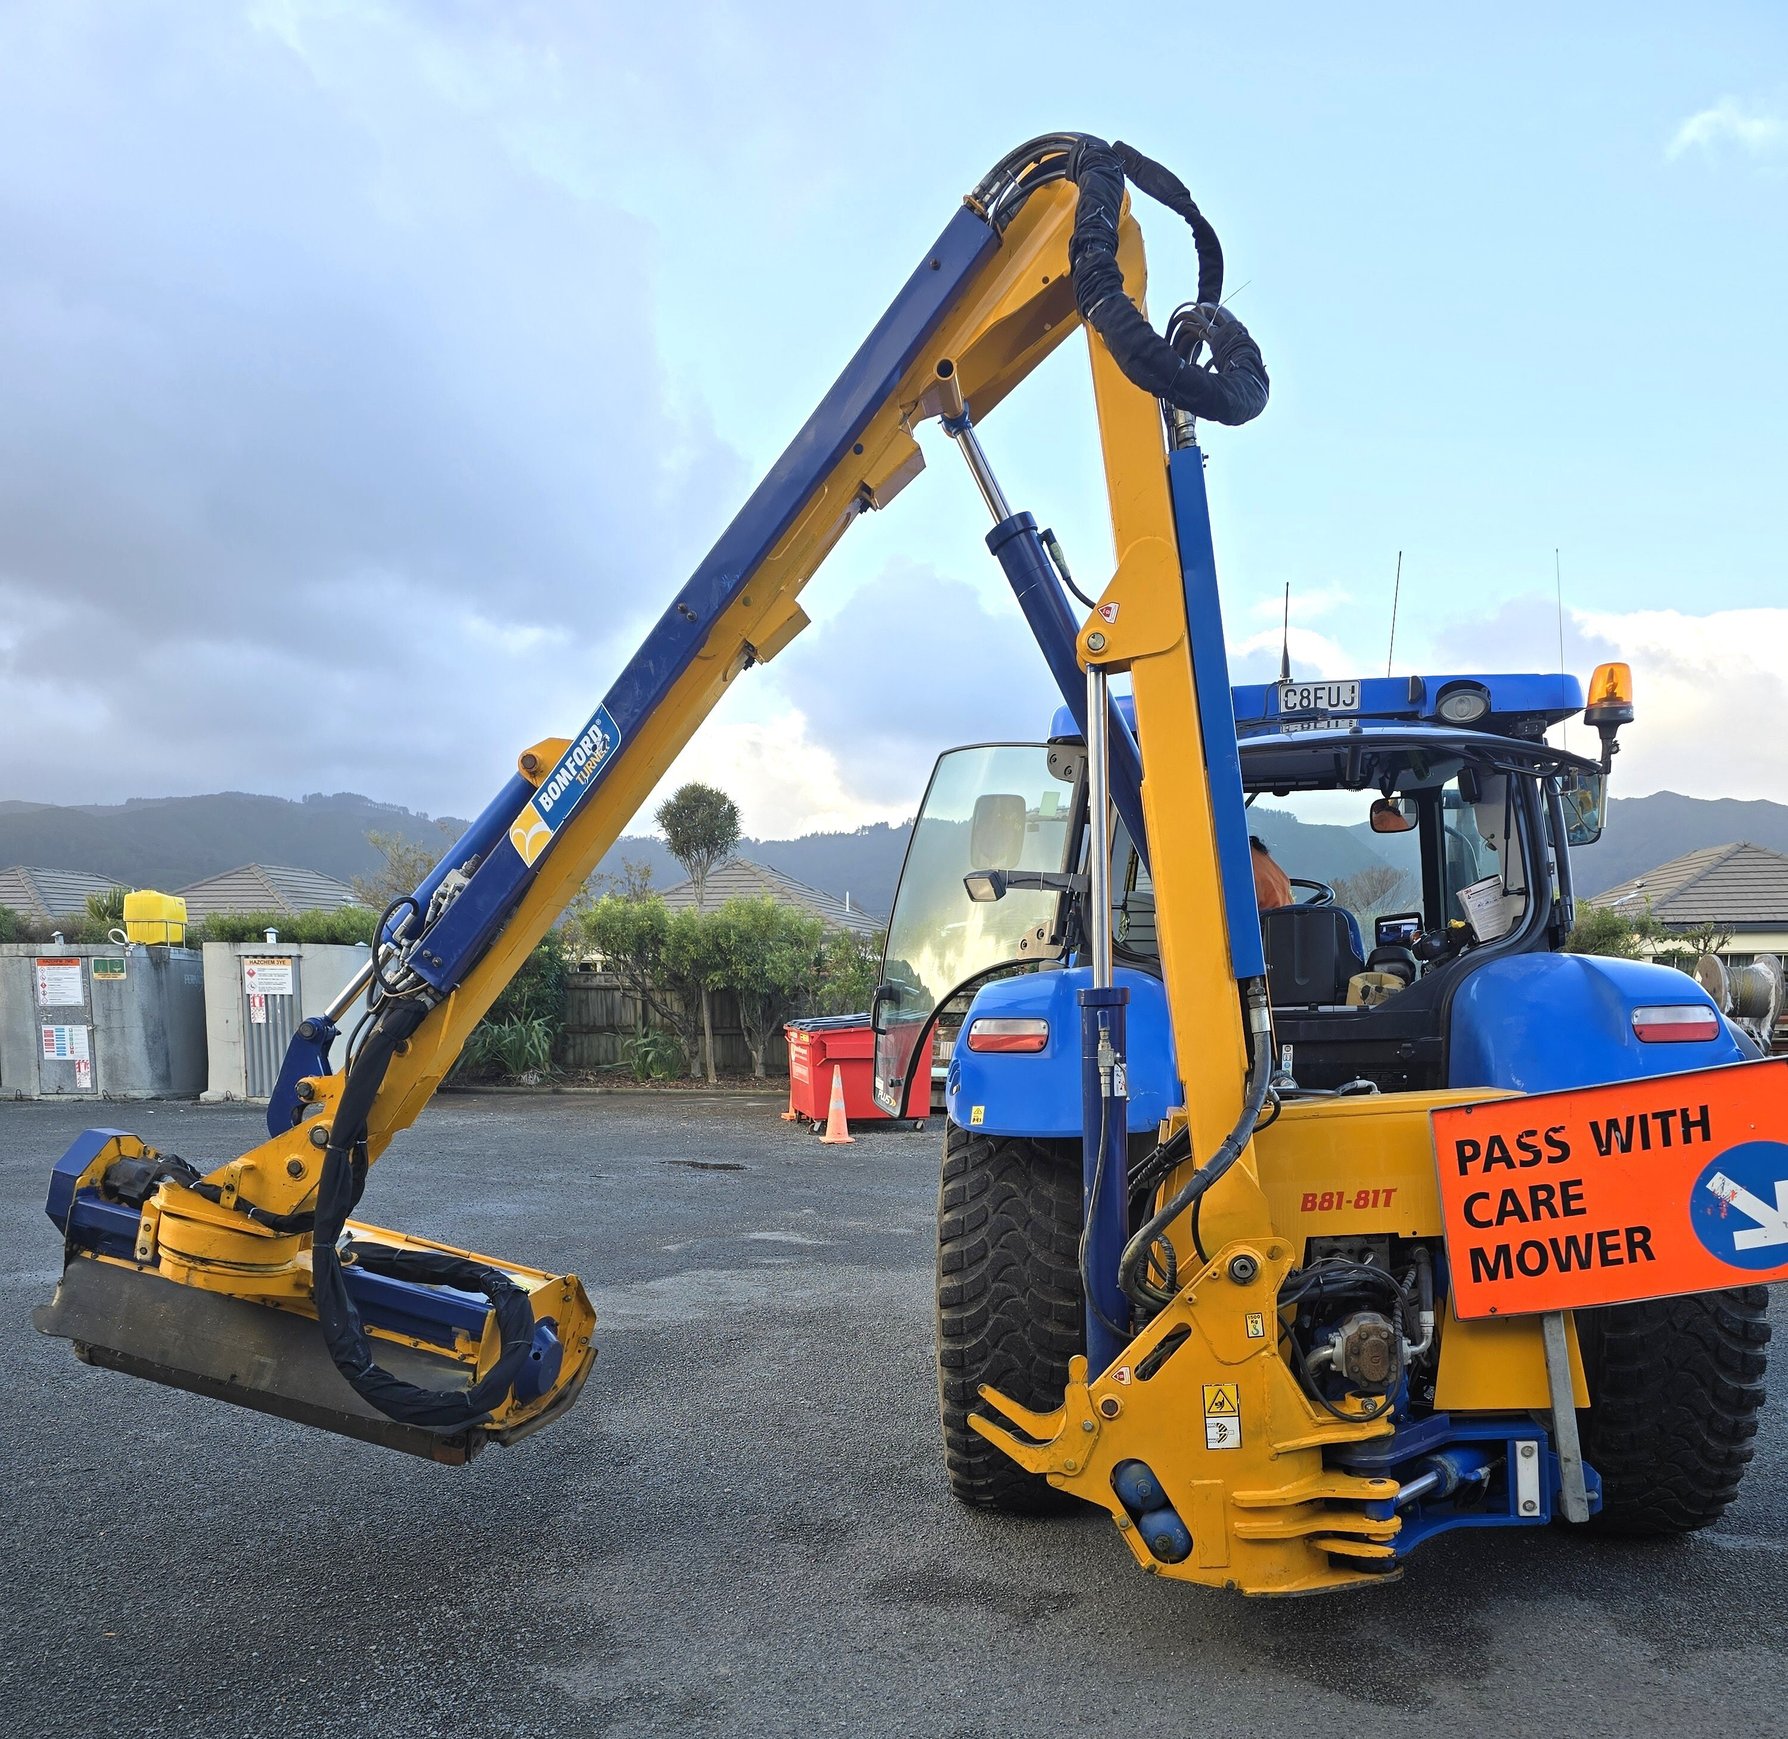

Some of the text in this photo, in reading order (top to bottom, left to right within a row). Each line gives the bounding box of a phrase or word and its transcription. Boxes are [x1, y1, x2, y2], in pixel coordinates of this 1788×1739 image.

[1284, 685, 1355, 710] C8FUJ
[1455, 1104, 1712, 1177] PASS WITH
[1301, 1188, 1398, 1212] B81-81T
[1463, 1178, 1587, 1229] CARE
[1469, 1225, 1656, 1284] MOWER
